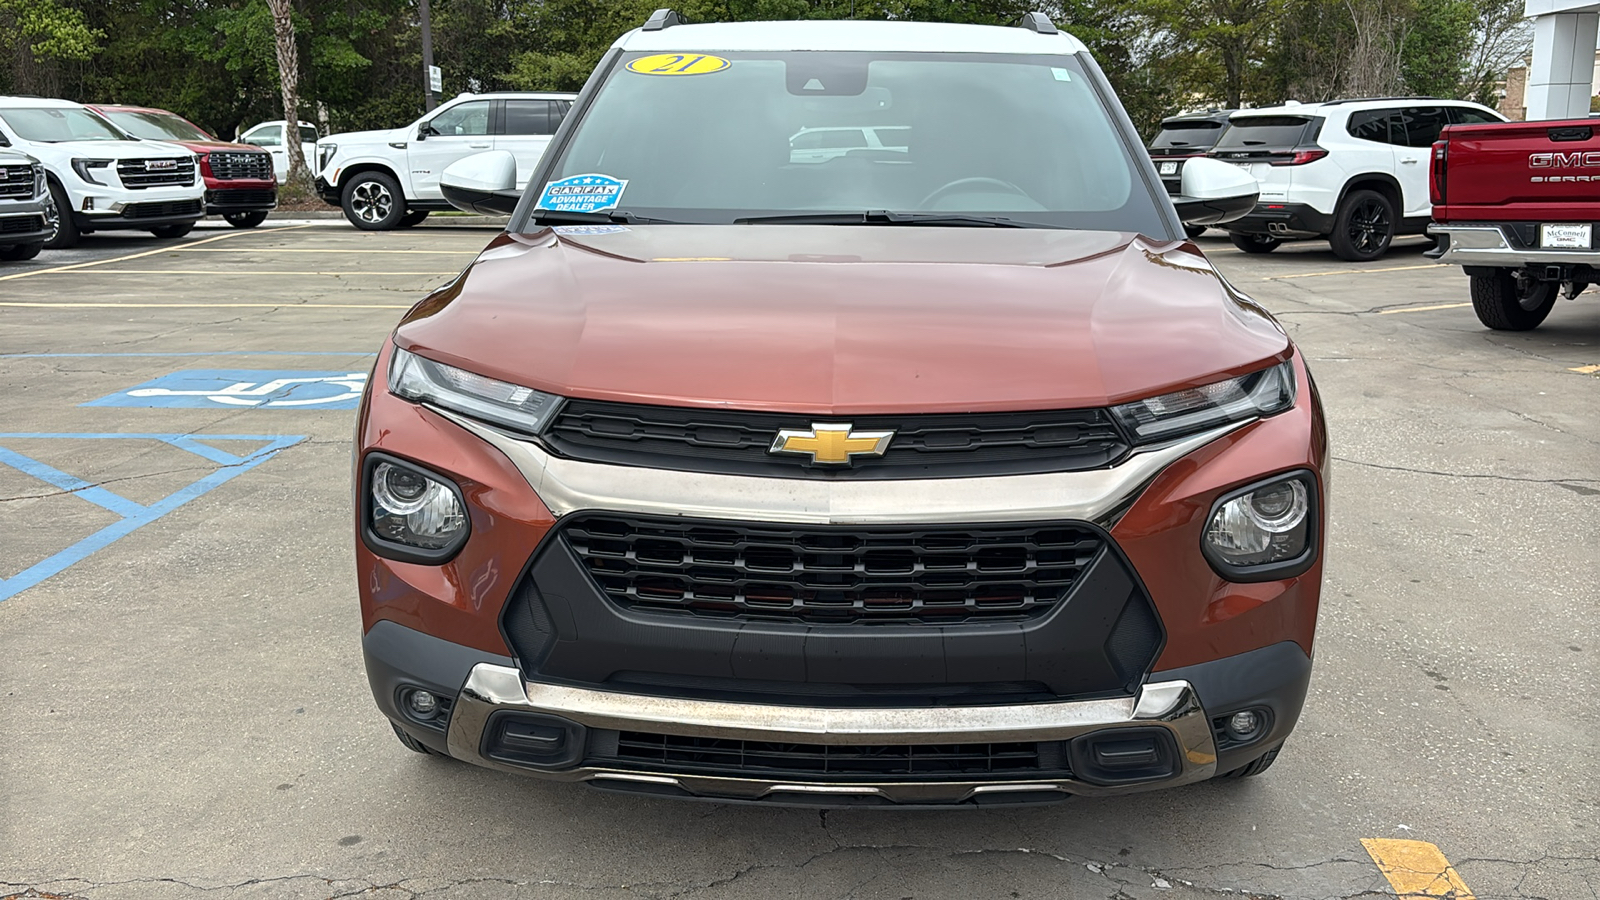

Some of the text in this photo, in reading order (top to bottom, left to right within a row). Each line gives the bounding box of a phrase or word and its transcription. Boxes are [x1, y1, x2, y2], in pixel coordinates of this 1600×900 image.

[648, 55, 706, 73] 21
[1529, 152, 1600, 168] GMC
[549, 186, 615, 195] CARFAX
[549, 195, 608, 204] ADVANTAGE
[555, 203, 595, 211] DEALER
[1547, 229, 1587, 238] McConnell
